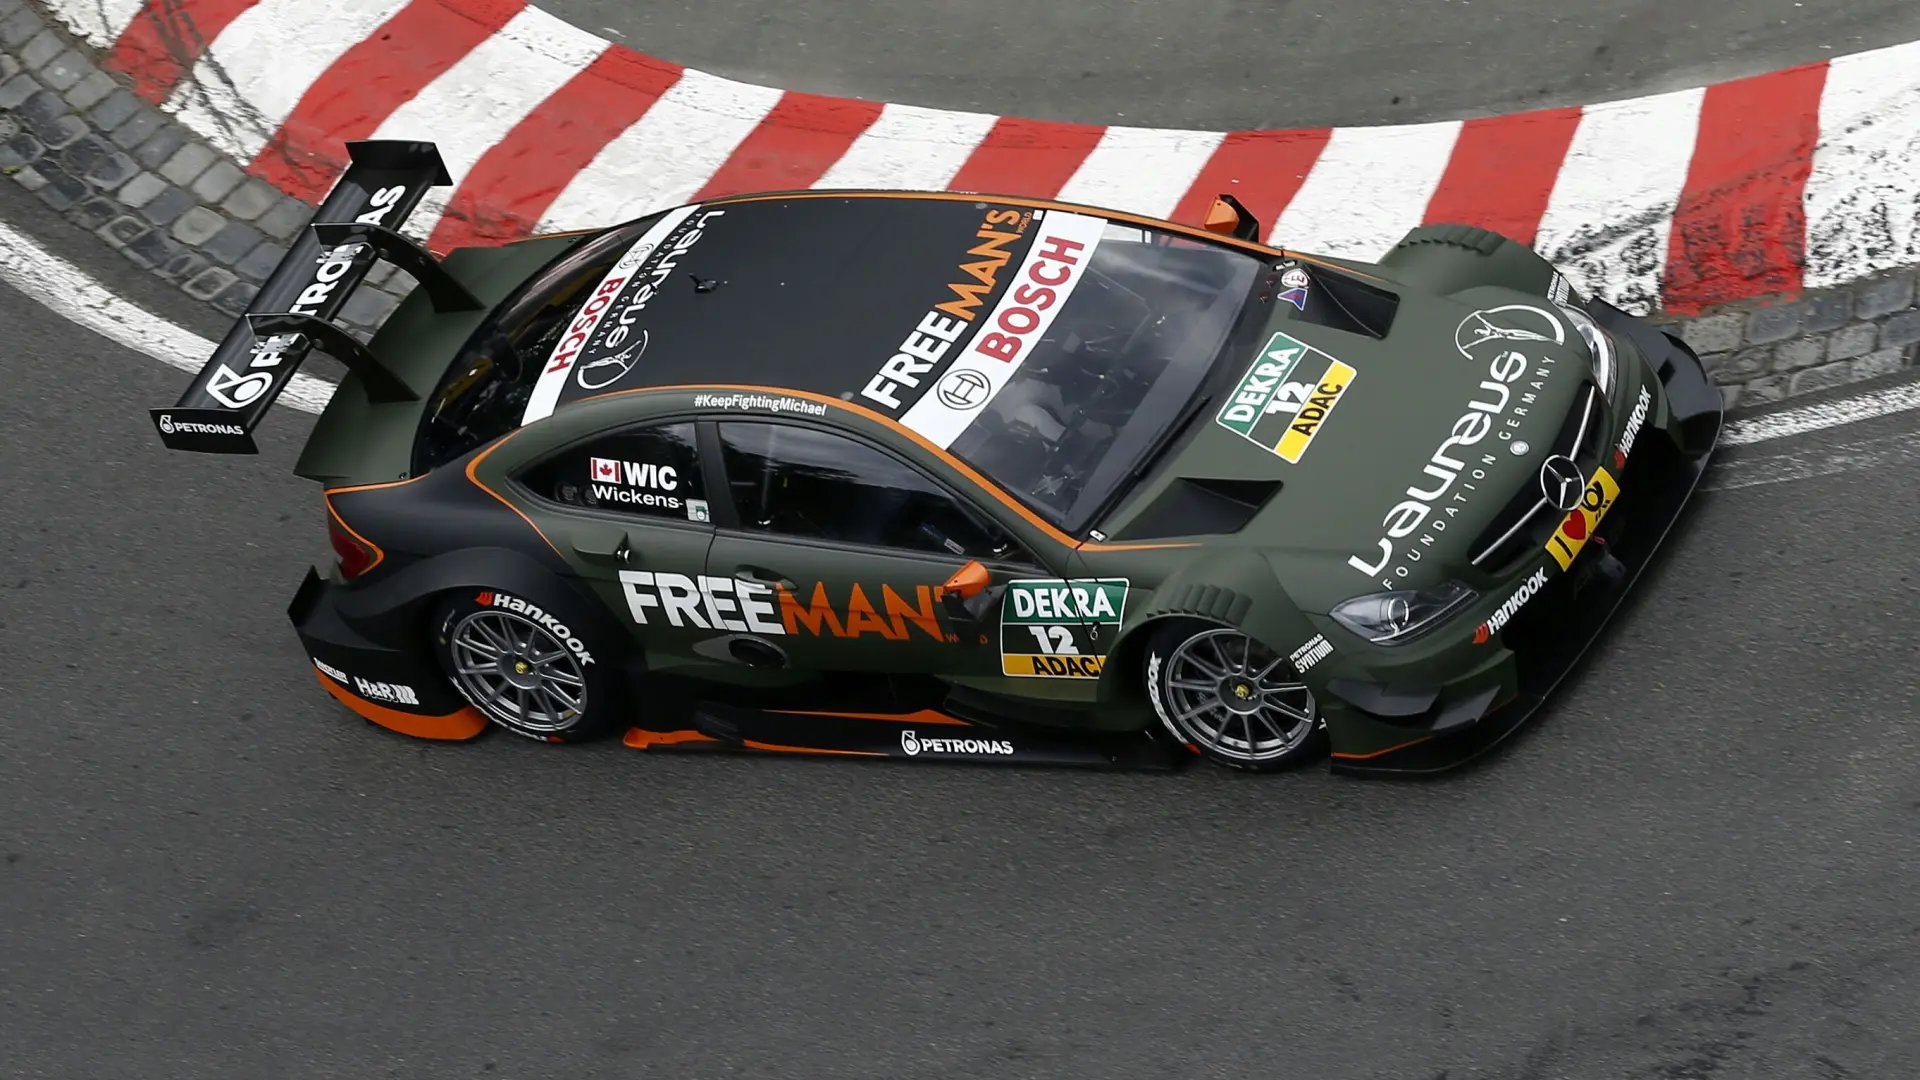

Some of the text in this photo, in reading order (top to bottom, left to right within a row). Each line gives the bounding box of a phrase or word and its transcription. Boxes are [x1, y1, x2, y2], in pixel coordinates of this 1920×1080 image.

[860, 209, 1022, 410] FREEMAN'S
[975, 235, 1085, 363] BOSCH
[546, 277, 626, 374] BOSCH
[1224, 348, 1300, 423] DEKRA
[1265, 381, 1316, 415] 12
[694, 394, 828, 416] #KeepFightingMichael
[1291, 383, 1343, 436] ADAC
[174, 421, 244, 435] PETRONAS
[623, 461, 678, 491] WIC
[1382, 355, 1556, 591] FOUNDATION GERMANY
[1012, 586, 1116, 618] DEKRA
[1031, 626, 1080, 655] 12
[1289, 633, 1324, 662] PETRONAS
[1031, 655, 1103, 678] ADAC
[353, 676, 395, 700] H&R
[920, 738, 1014, 755] PETRONAS
